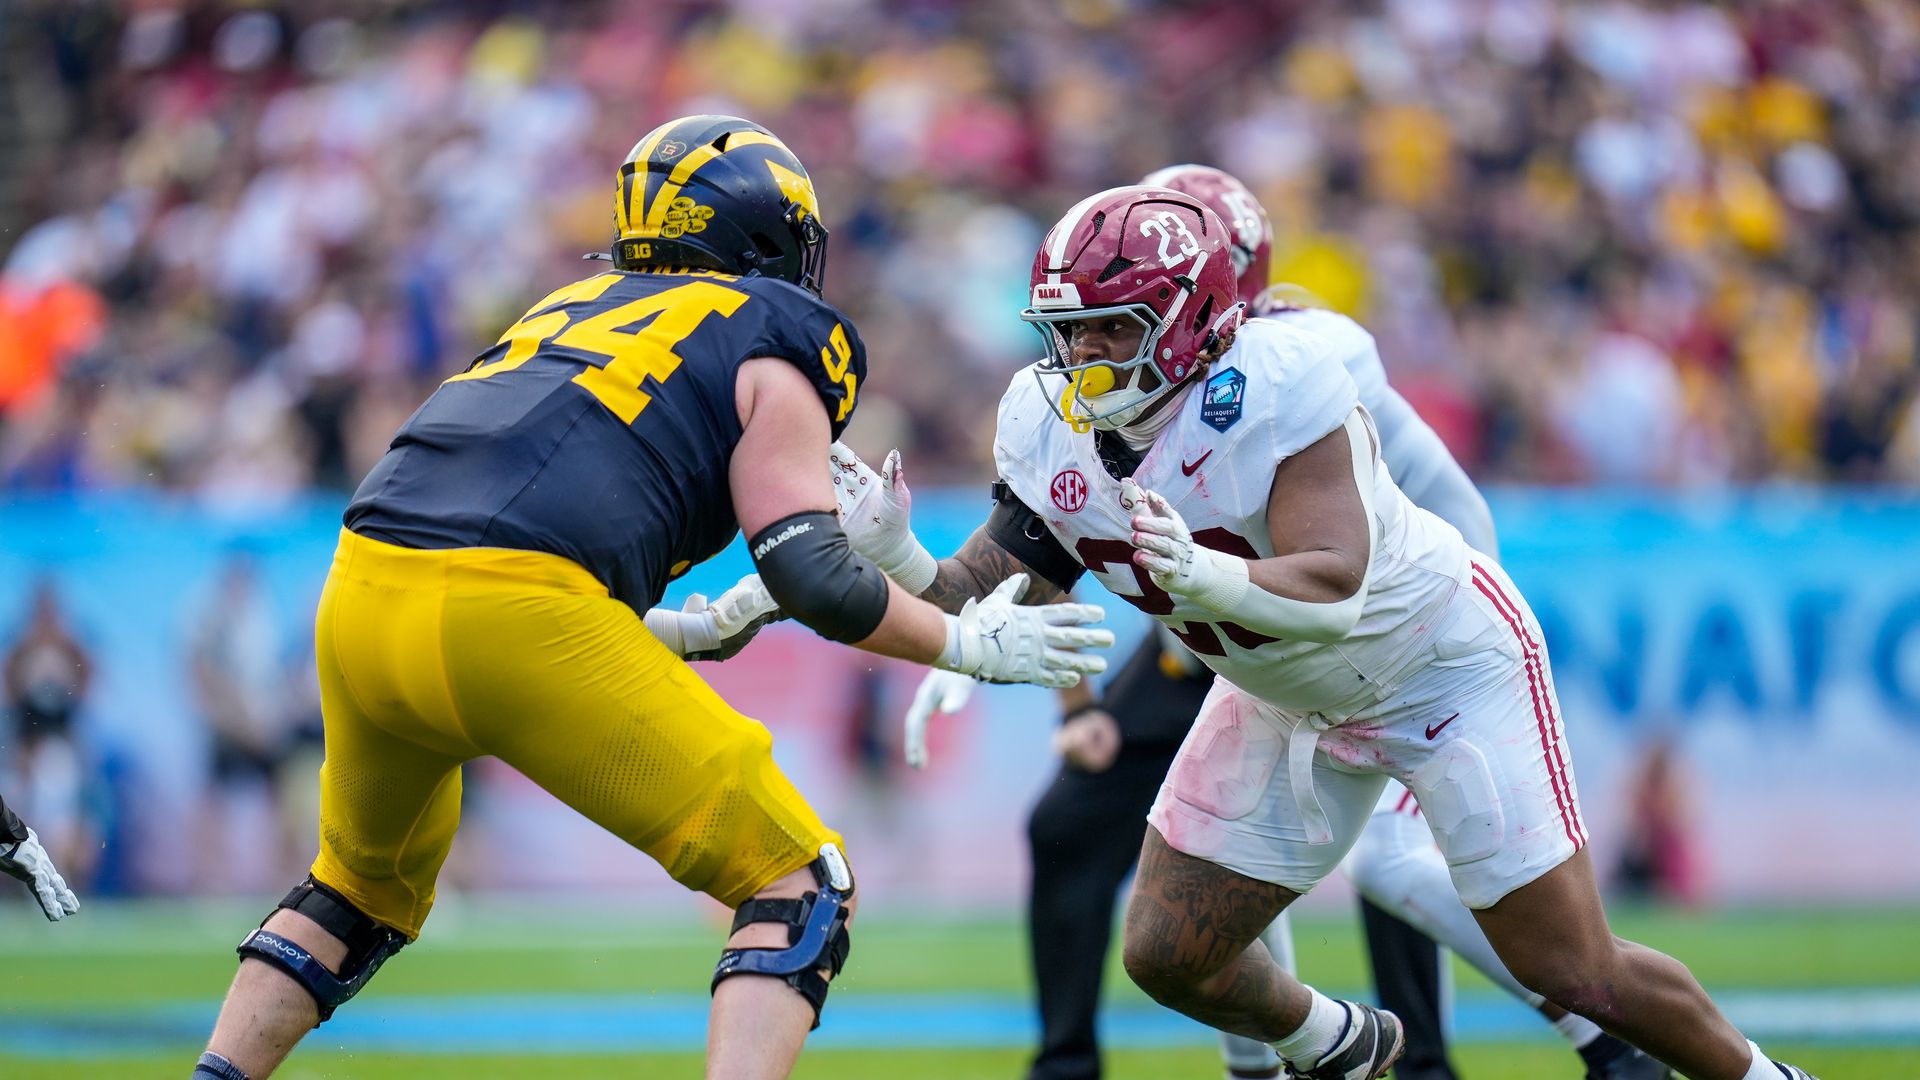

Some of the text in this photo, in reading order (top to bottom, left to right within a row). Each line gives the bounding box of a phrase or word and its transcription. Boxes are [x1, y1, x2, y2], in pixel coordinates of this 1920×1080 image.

[1139, 211, 1199, 270] 23
[1038, 288, 1062, 299] BAMA
[444, 274, 750, 426] 54
[1053, 472, 1086, 510] SEC
[255, 934, 307, 960] DONJOY
